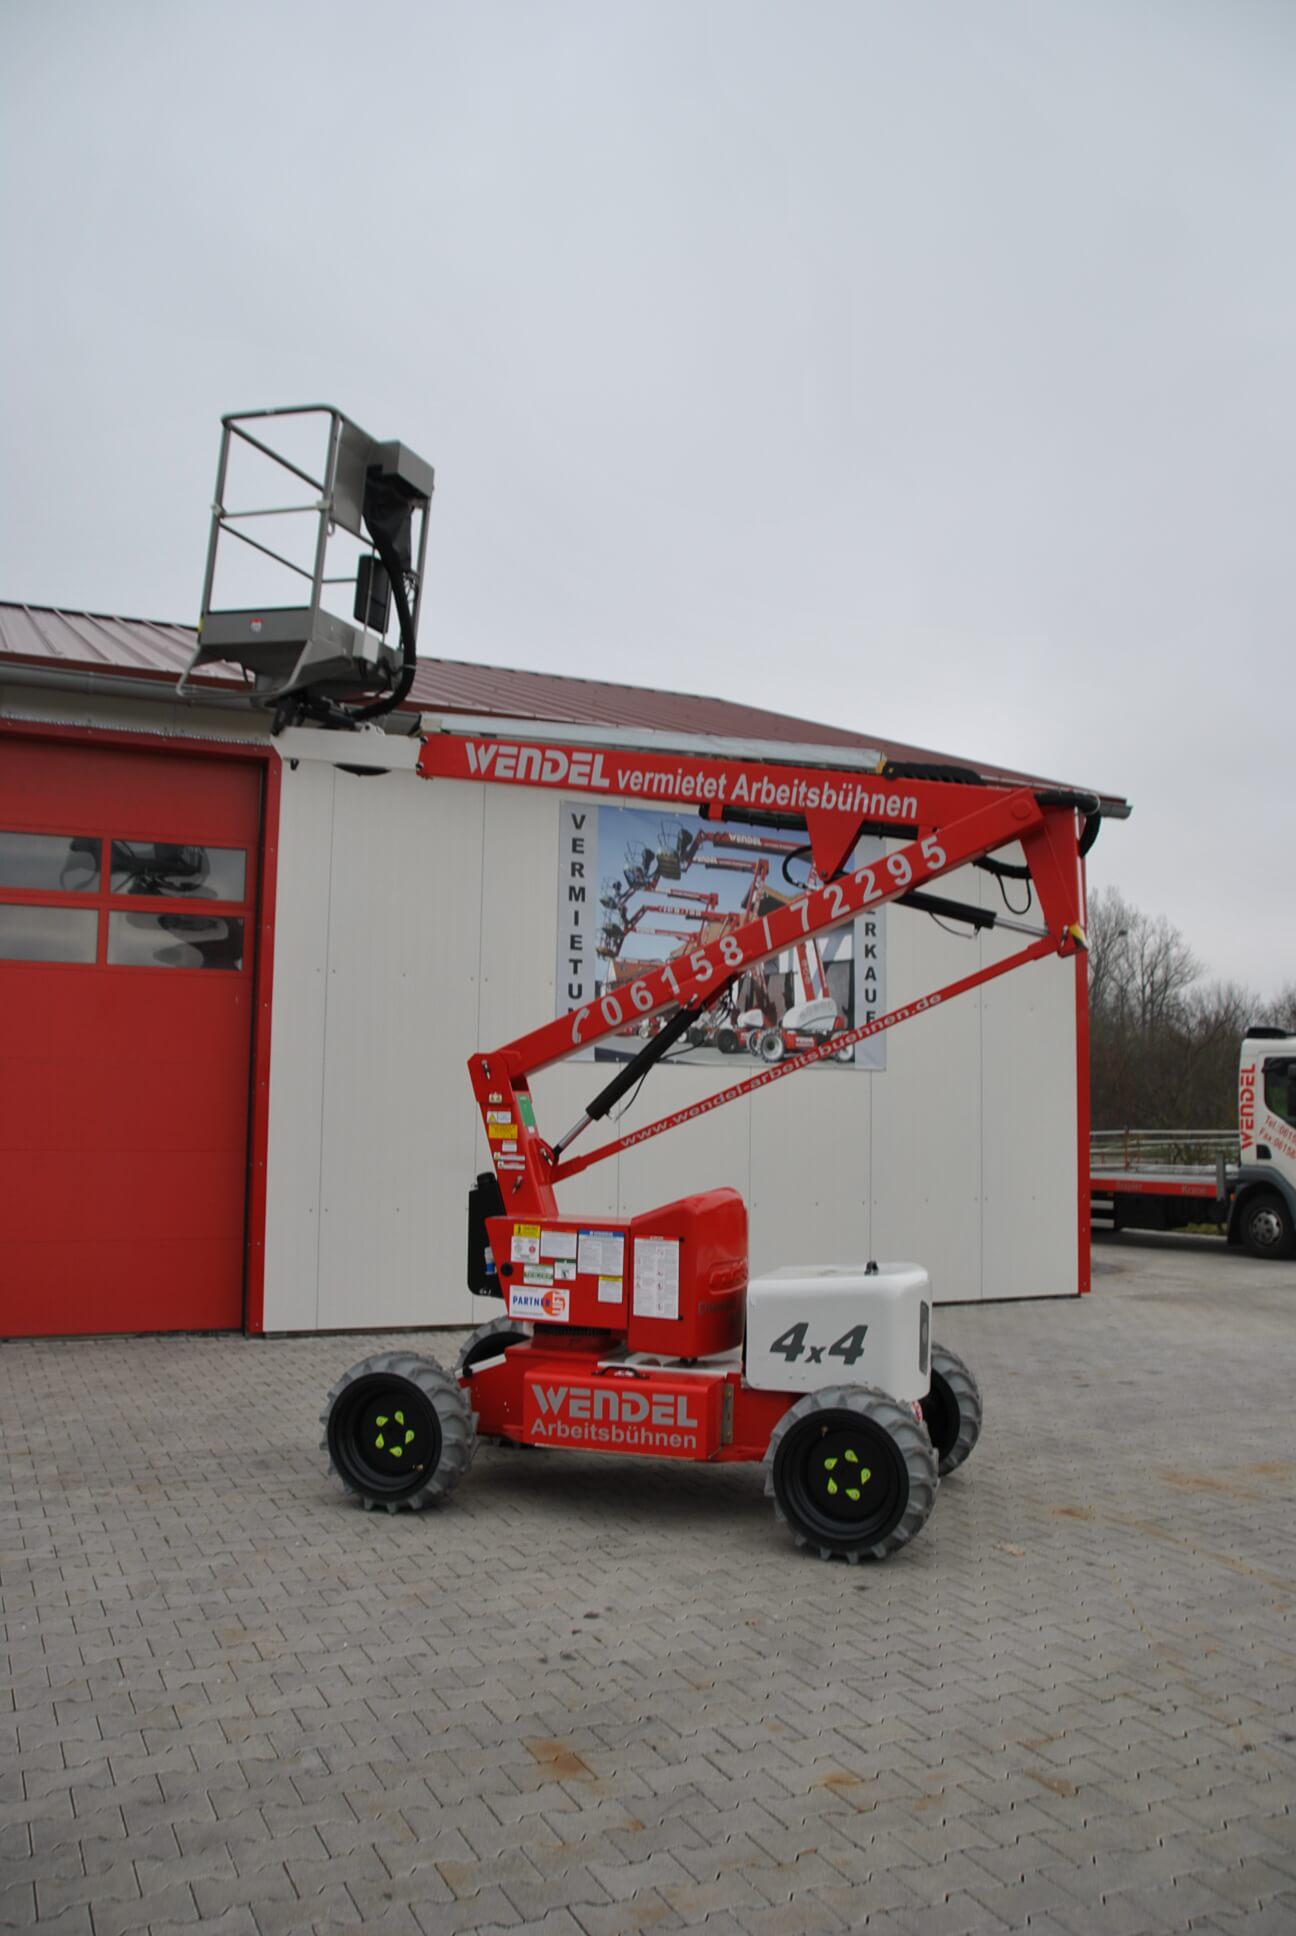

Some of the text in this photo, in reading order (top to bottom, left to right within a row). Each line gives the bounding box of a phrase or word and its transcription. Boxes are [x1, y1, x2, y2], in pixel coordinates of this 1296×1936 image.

[465, 741, 917, 818] WENDEL vermietet Arbeitsbühnen
[567, 813, 587, 1013] VERMIETU
[620, 992, 942, 1149] www.wendel-arbeitsbuehnen.de
[1239, 1063, 1256, 1151] WENDEL
[769, 1322, 869, 1366] 4x4
[530, 1383, 698, 1428] WENDEL
[530, 1419, 697, 1450] Arbeitsbühnen
